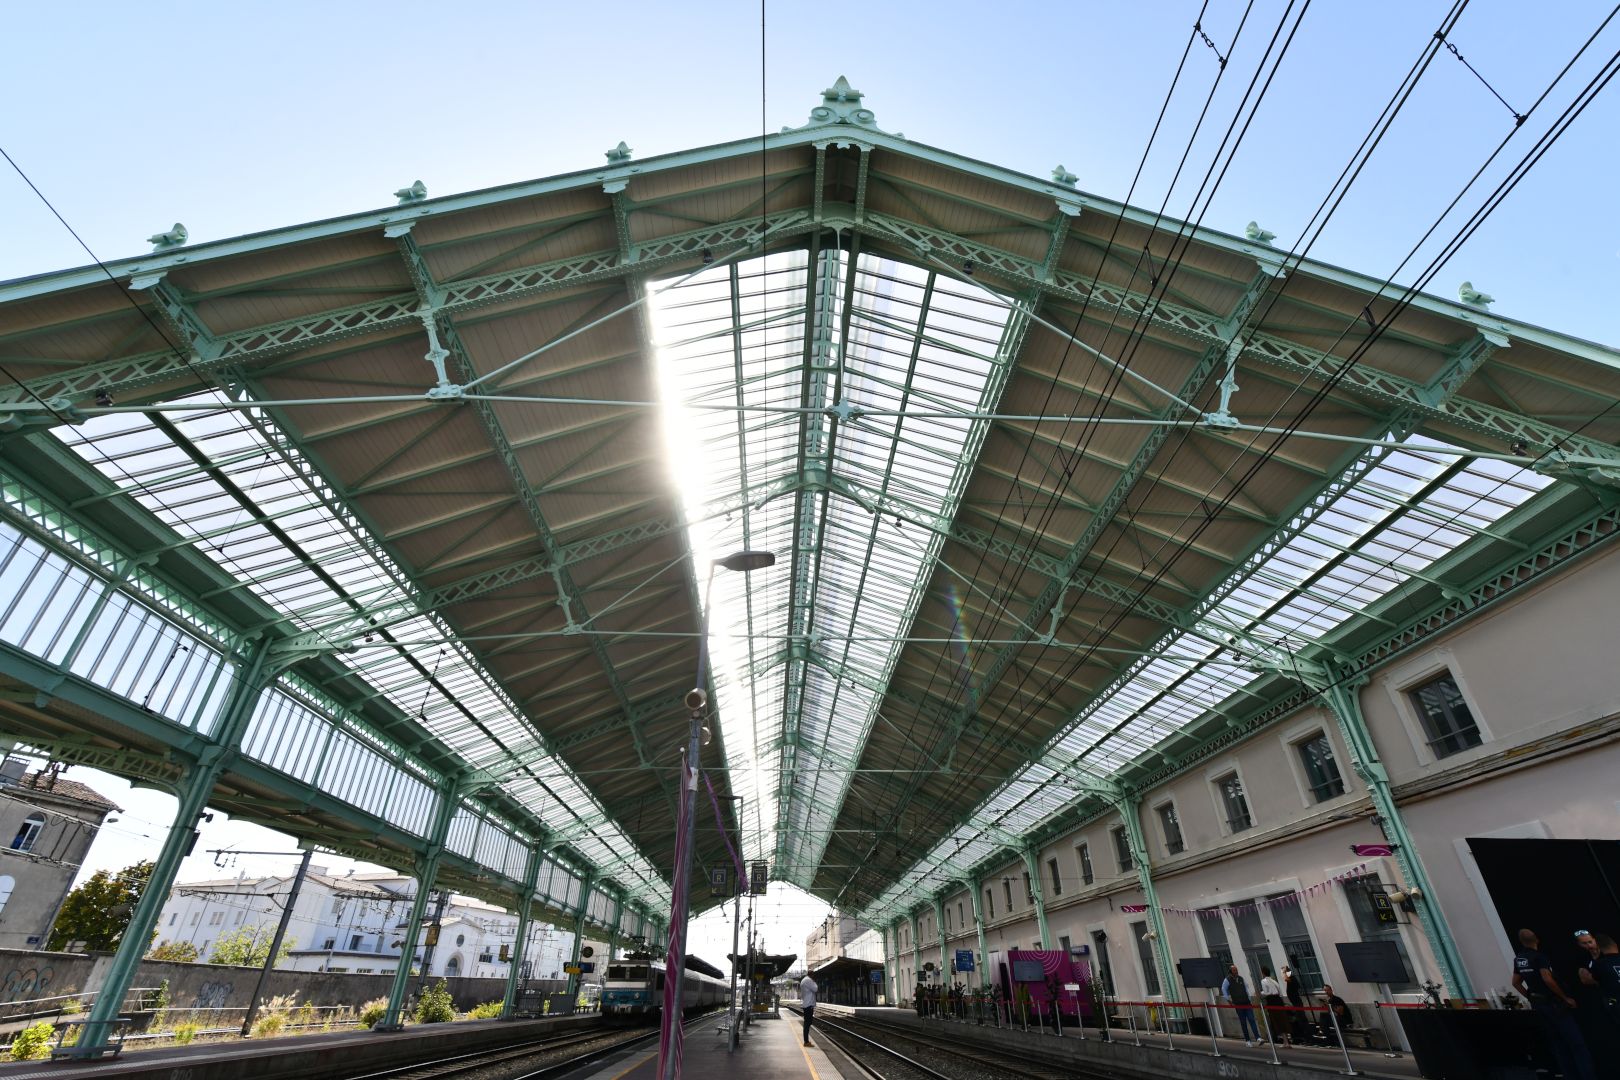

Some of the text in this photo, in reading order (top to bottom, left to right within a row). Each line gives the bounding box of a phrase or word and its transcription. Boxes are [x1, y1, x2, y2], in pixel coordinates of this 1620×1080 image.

[716, 874, 722, 882] R
[756, 873, 762, 881] R
[1379, 898, 1387, 908] R
